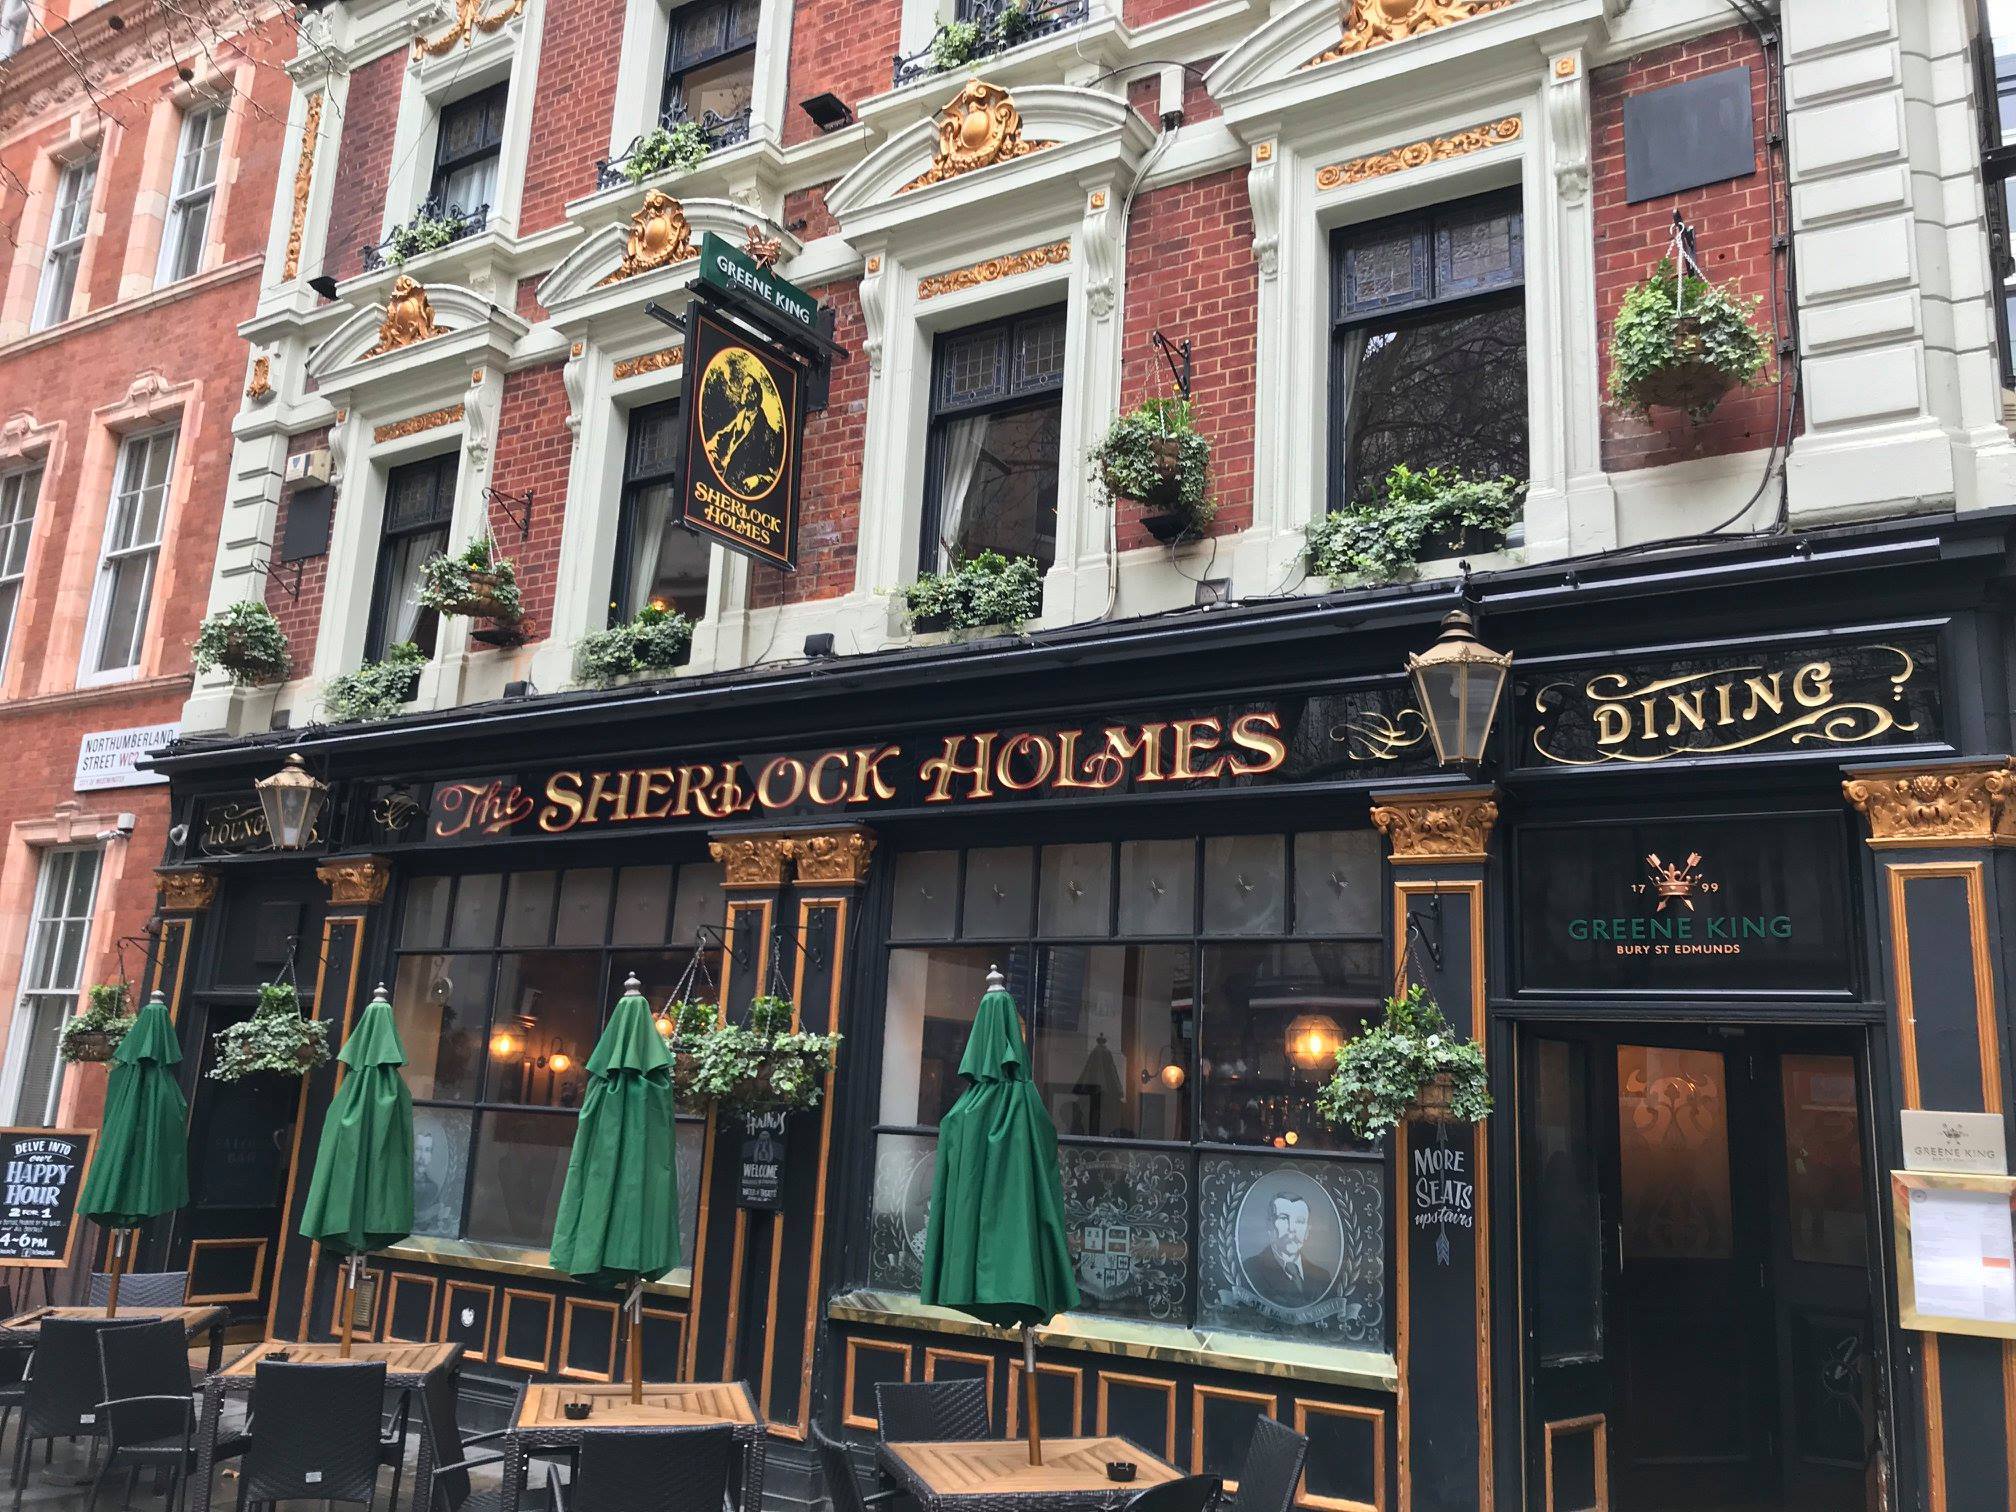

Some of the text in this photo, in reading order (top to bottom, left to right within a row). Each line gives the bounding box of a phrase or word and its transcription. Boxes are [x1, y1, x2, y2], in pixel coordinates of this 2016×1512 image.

[717, 255, 810, 325] GREENE KING
[694, 481, 782, 534] SHERLOCK
[704, 505, 771, 544] HOLMES
[1593, 661, 1835, 745] DINING
[86, 729, 174, 753] NORTHUMBERLAND
[82, 753, 117, 771] STREET
[435, 711, 1286, 836] The SHERLOCK HOLMES
[1567, 915, 1793, 941] GREENE KING
[1616, 944, 1741, 955] BURY ST EDMUNDS
[15, 1140, 71, 1155] DELVE INTO
[1914, 1146, 1961, 1158] GREENE
[1965, 1149, 1995, 1160] KING
[4, 1161, 74, 1185] HAPPY
[743, 1163, 779, 1179] WELCOME
[1414, 1147, 1465, 1176] MORE
[3, 1185, 60, 1207] HOUR
[1415, 1177, 1473, 1209] SEATS
[9, 1208, 21, 1217] 2
[41, 1208, 51, 1218] 1
[1414, 1206, 1473, 1229] upstairs
